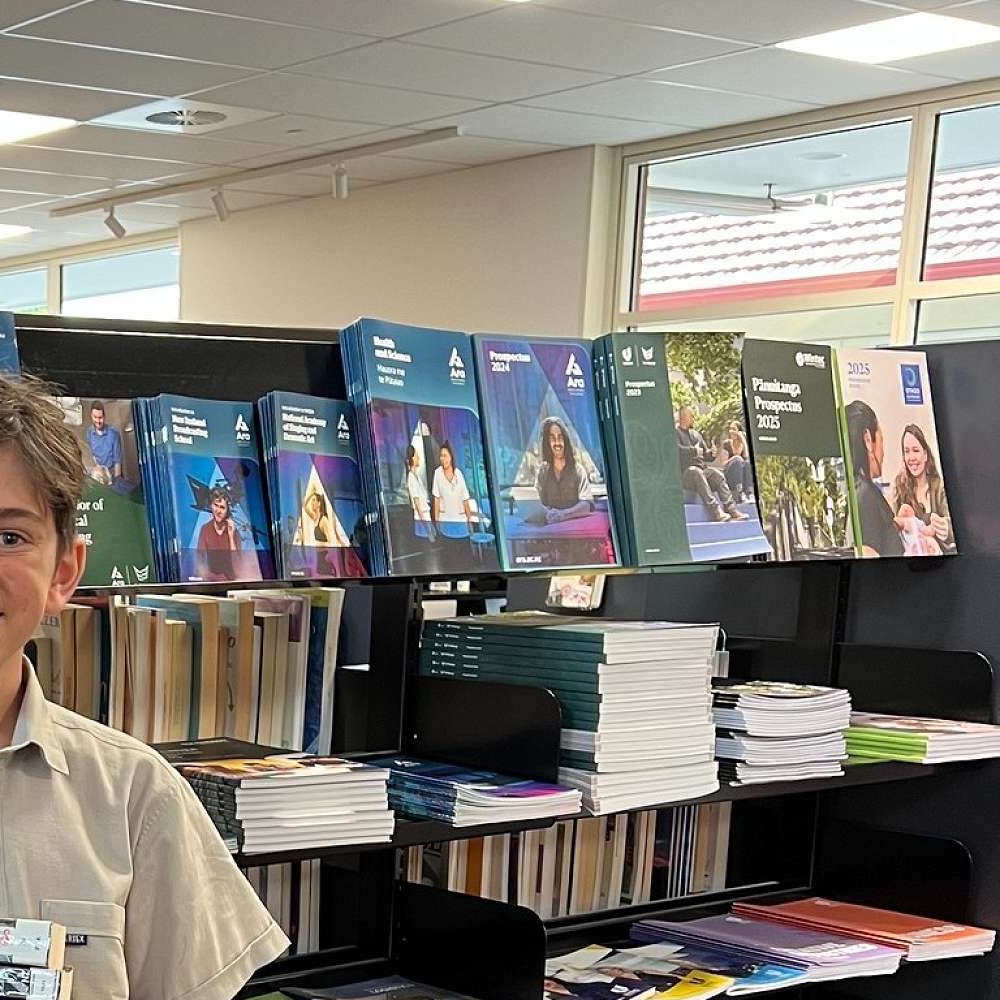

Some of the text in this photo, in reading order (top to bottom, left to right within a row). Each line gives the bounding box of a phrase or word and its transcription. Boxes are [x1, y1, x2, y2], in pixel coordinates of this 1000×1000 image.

[489, 350, 531, 363] Prospectus
[491, 361, 510, 372] 2024
[848, 362, 871, 375] 2025
[567, 376, 584, 388] Ara
[754, 395, 803, 414] Prospectus
[756, 414, 781, 429] 2025
[92, 498, 104, 511] of
